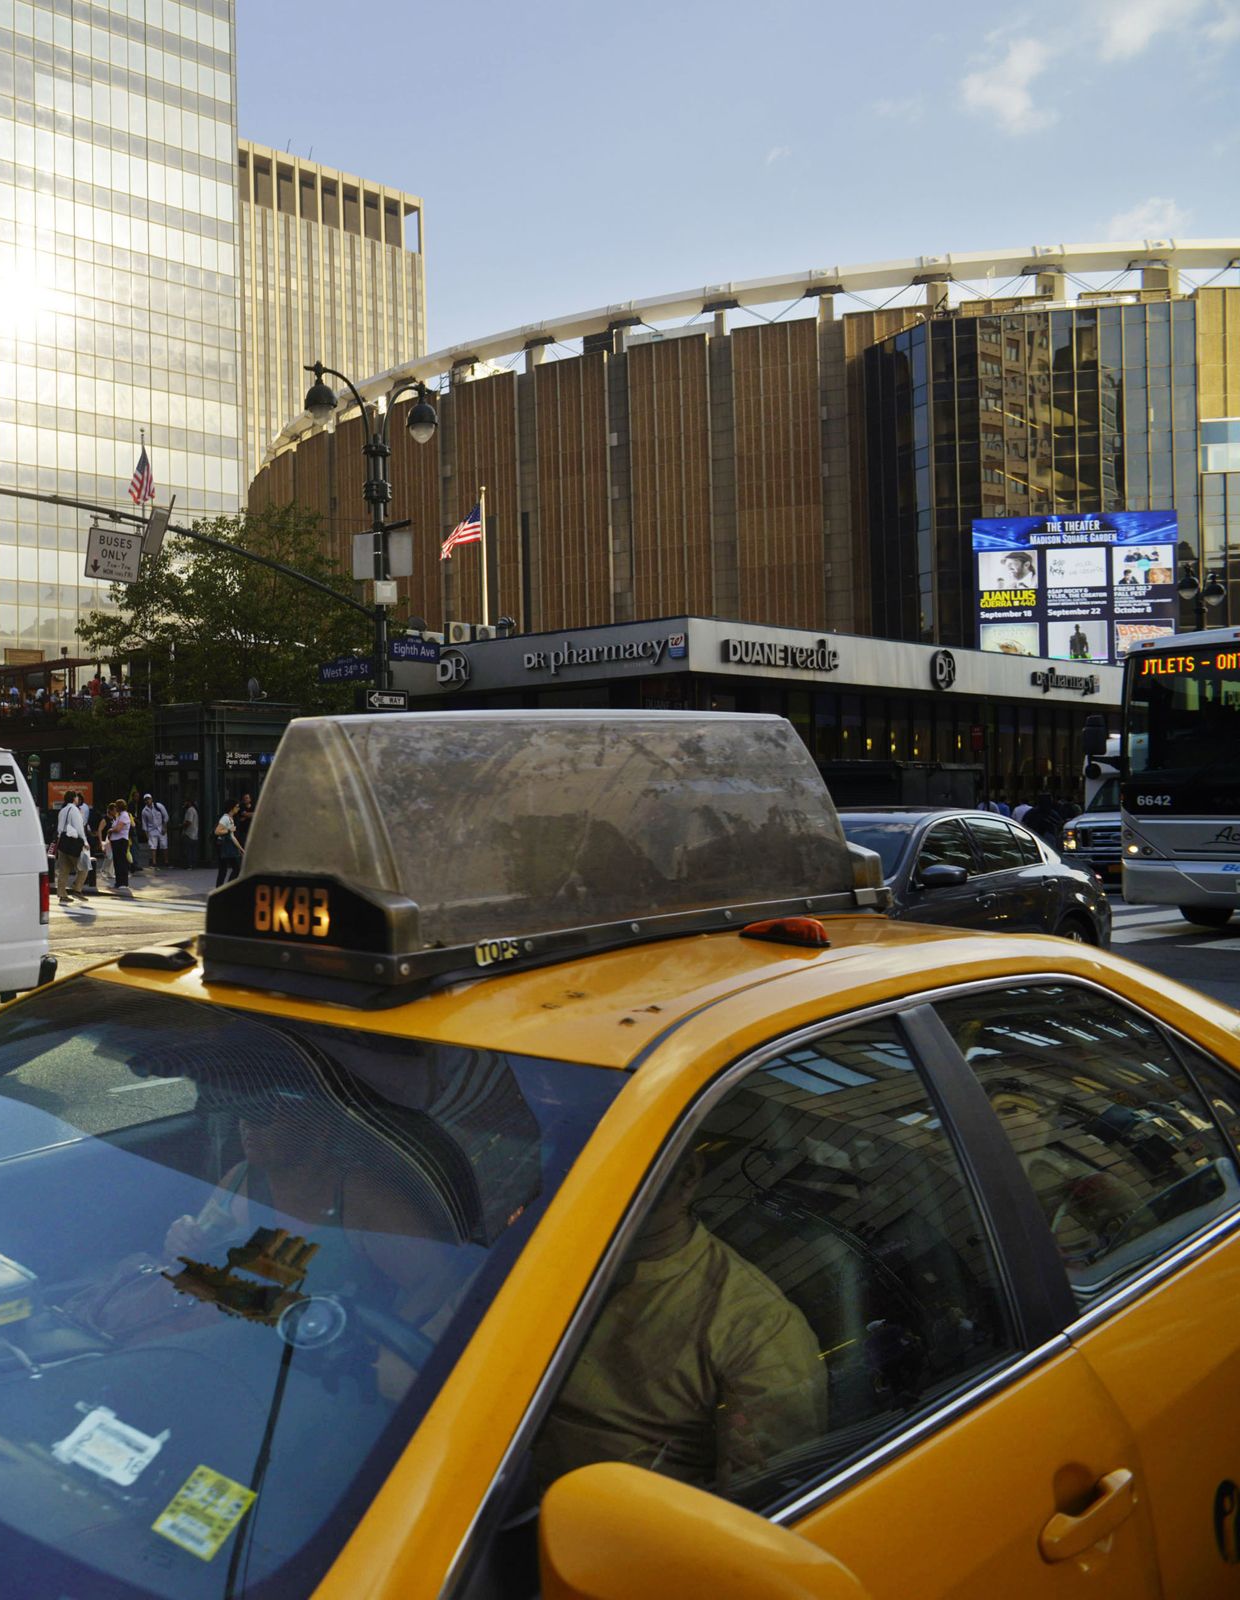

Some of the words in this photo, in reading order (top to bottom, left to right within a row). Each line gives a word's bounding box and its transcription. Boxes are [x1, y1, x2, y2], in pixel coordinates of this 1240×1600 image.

[1046, 521, 1062, 532] THE
[1064, 520, 1100, 531] THEATER
[99, 535, 132, 549] BUSES
[1029, 534, 1061, 545] MADISON
[1062, 534, 1088, 544] SQUARE
[1090, 533, 1117, 543] GARDEN
[101, 549, 128, 561] ONLY
[982, 591, 1010, 601] JUAN
[1011, 590, 1036, 600] LUIS
[980, 600, 1012, 608] GUERRA
[1114, 606, 1145, 614] October
[980, 610, 1022, 619] September
[1047, 608, 1090, 617] September
[1090, 607, 1101, 615] 22
[393, 643, 418, 657] Eighth
[420, 646, 436, 657] Ave
[523, 651, 546, 669] DR
[550, 639, 666, 674] pharmacy
[322, 668, 342, 679] West
[344, 664, 358, 676] 34th
[360, 664, 368, 674] St
[436, 656, 470, 682] DR
[936, 657, 955, 681] DR
[1044, 668, 1094, 695] pharmacy
[374, 696, 385, 704] ONE
[389, 696, 402, 704] WAY
[1136, 795, 1172, 806] 6642
[254, 884, 330, 938] 8K83
[477, 939, 520, 964] TOPS
